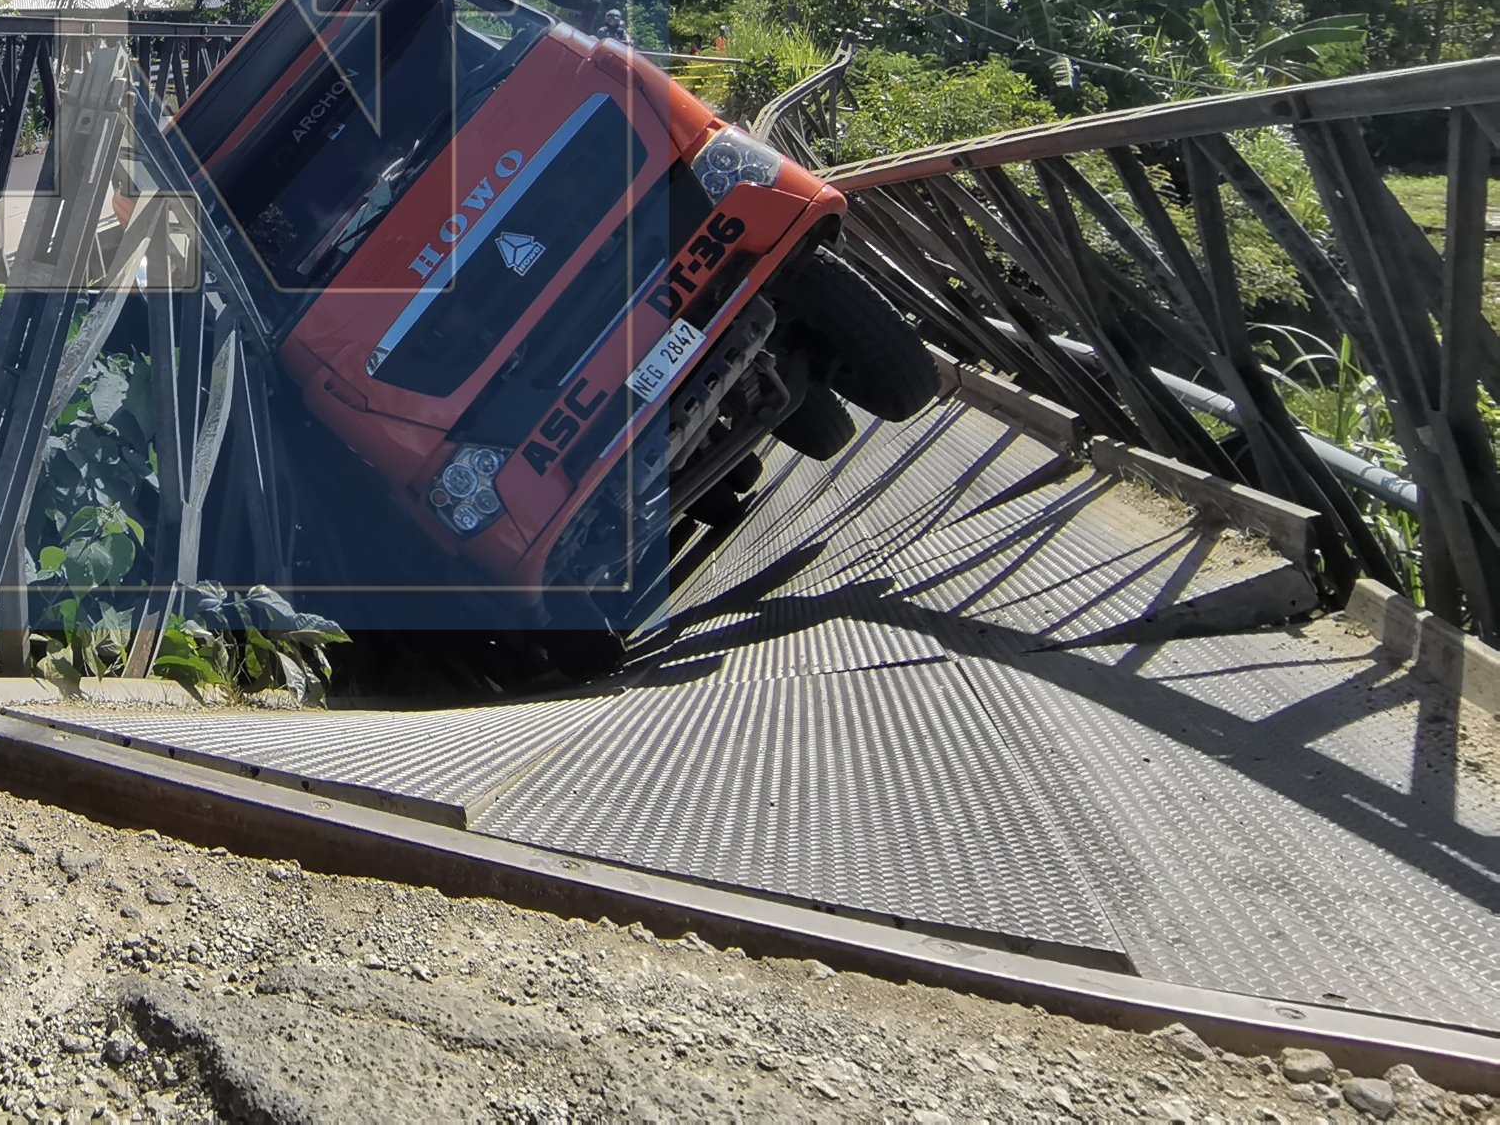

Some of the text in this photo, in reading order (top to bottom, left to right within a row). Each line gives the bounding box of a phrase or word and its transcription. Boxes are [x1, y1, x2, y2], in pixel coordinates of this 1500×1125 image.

[291, 67, 359, 144] ARCHON
[407, 149, 523, 280] HOWO
[632, 323, 696, 397] NEG 2847
[520, 377, 609, 477] ASC
